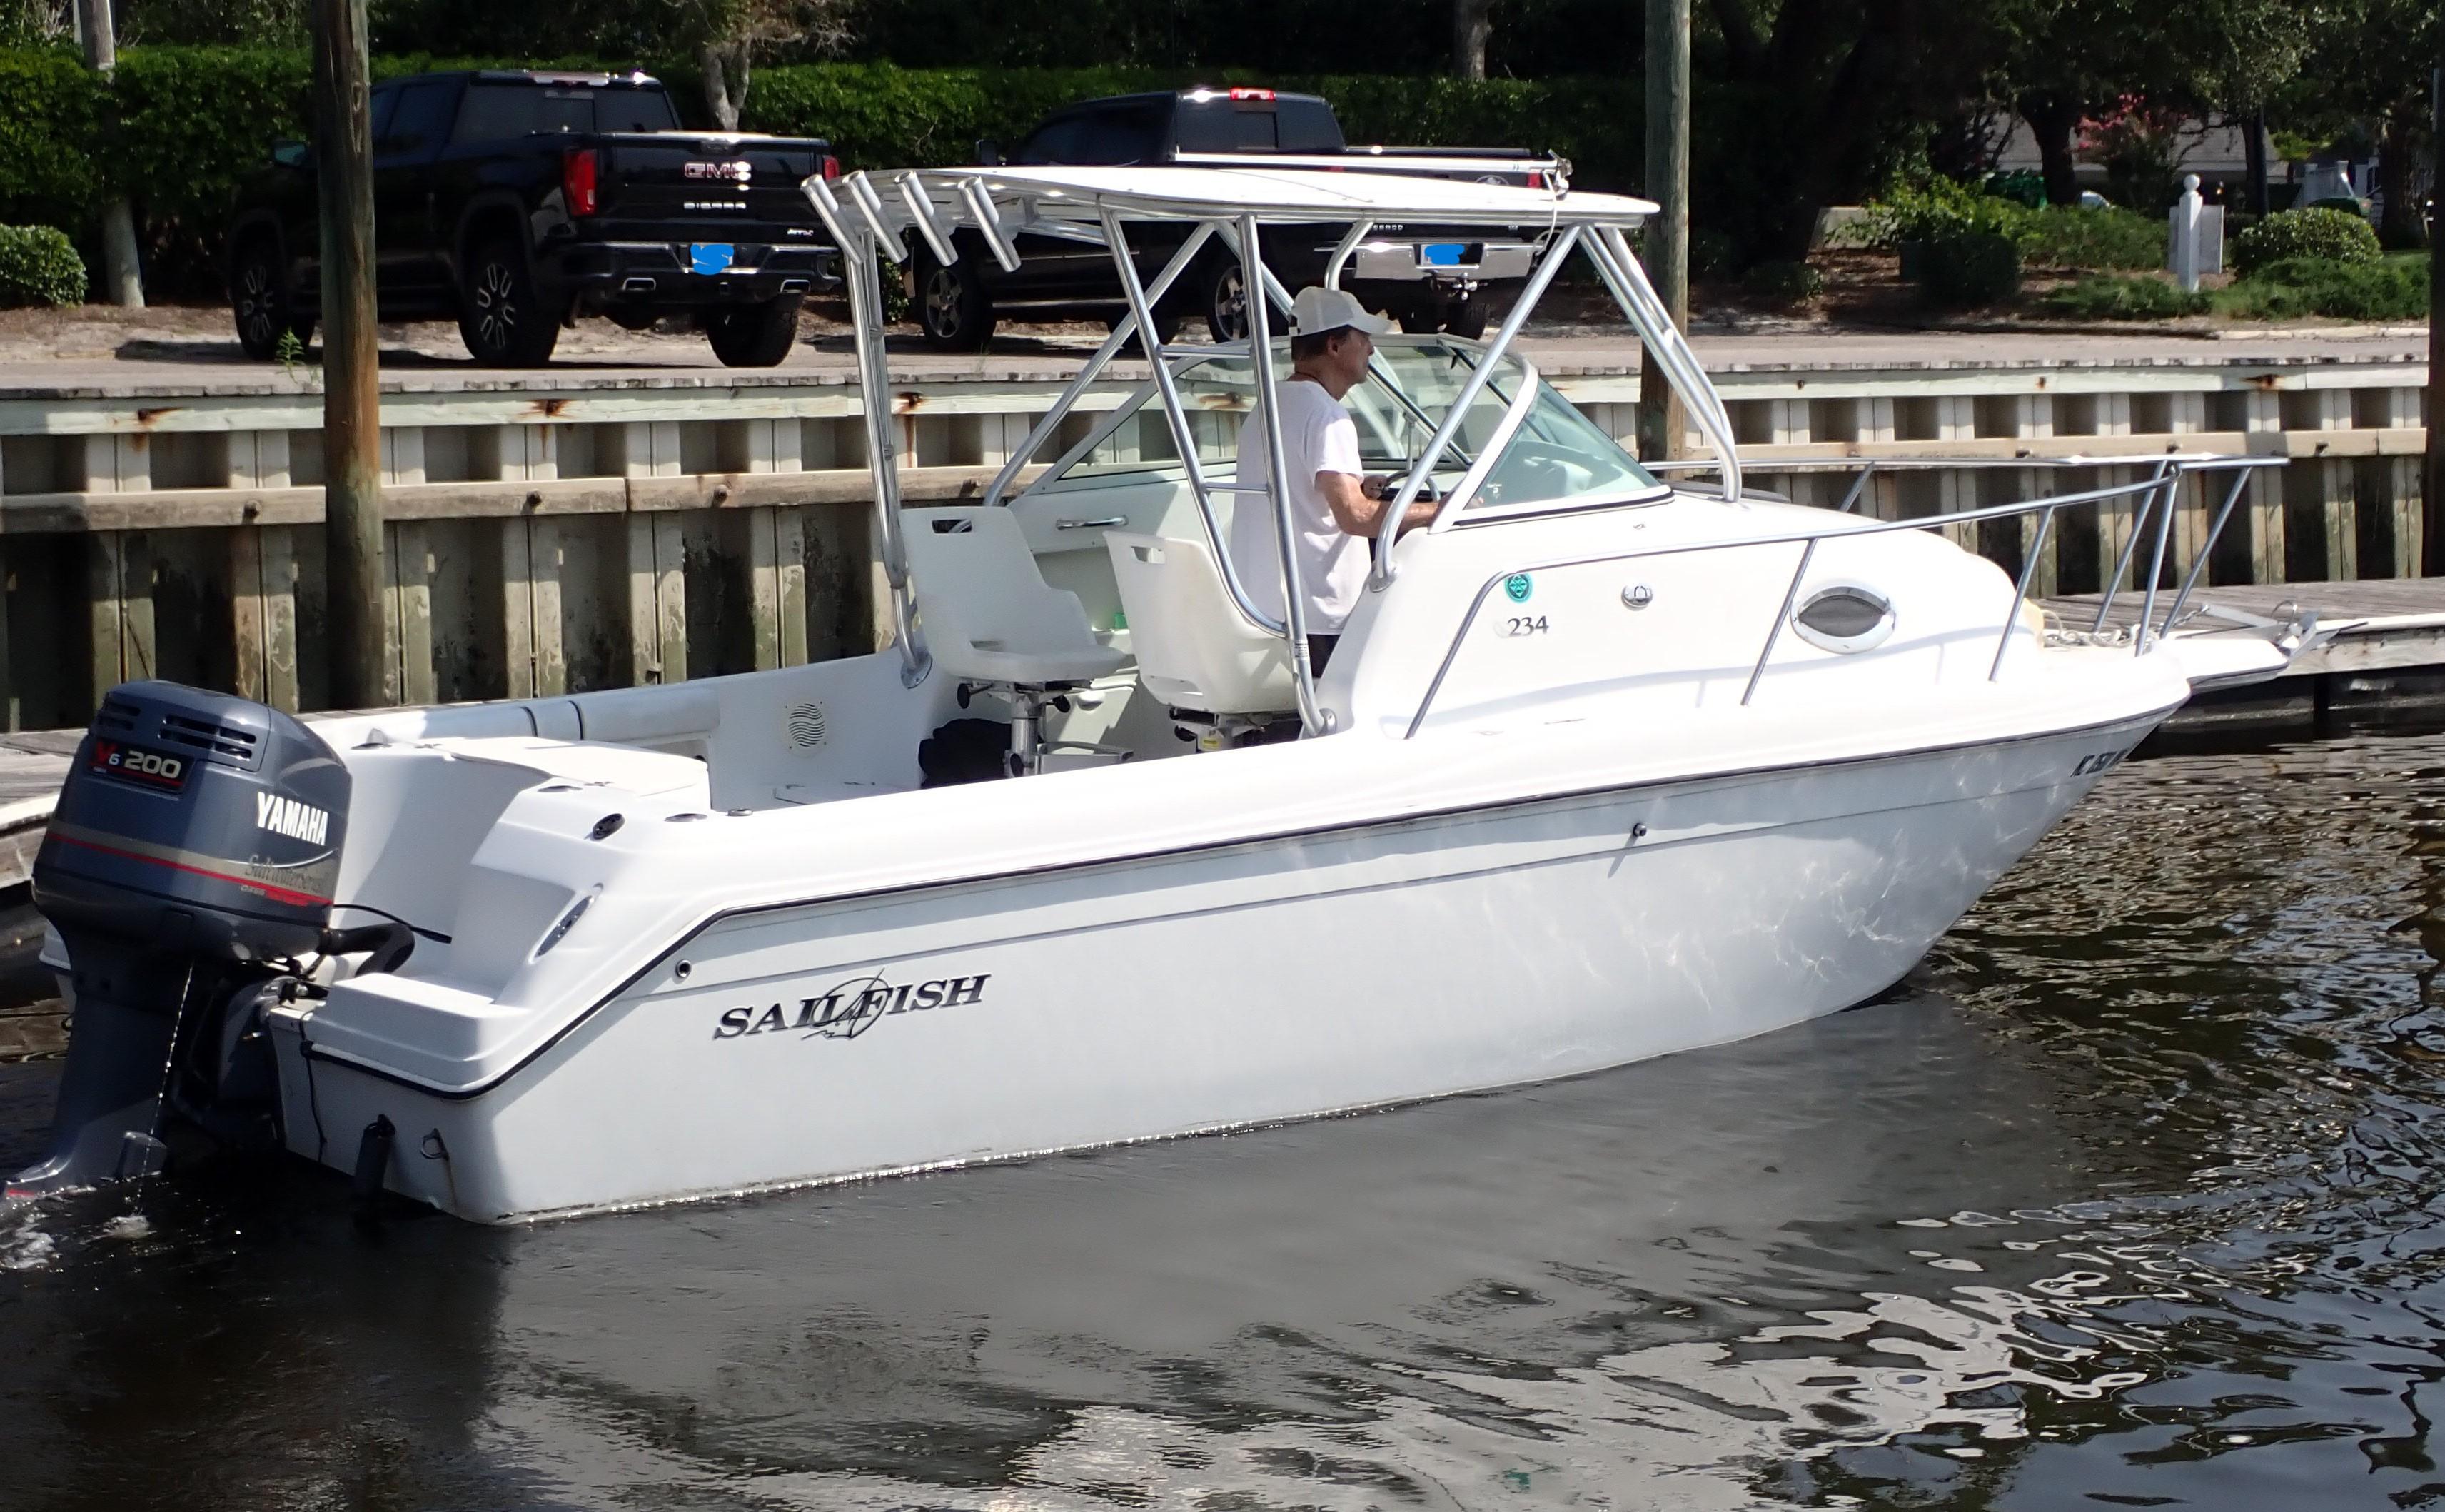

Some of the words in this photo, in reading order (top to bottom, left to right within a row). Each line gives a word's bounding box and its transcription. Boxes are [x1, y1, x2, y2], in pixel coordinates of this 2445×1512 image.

[685, 161, 751, 181] GMC
[1507, 615, 1549, 637] 234
[123, 750, 182, 779] 200
[258, 791, 328, 846] YAMAHA
[713, 974, 991, 1039] SAILFISH
